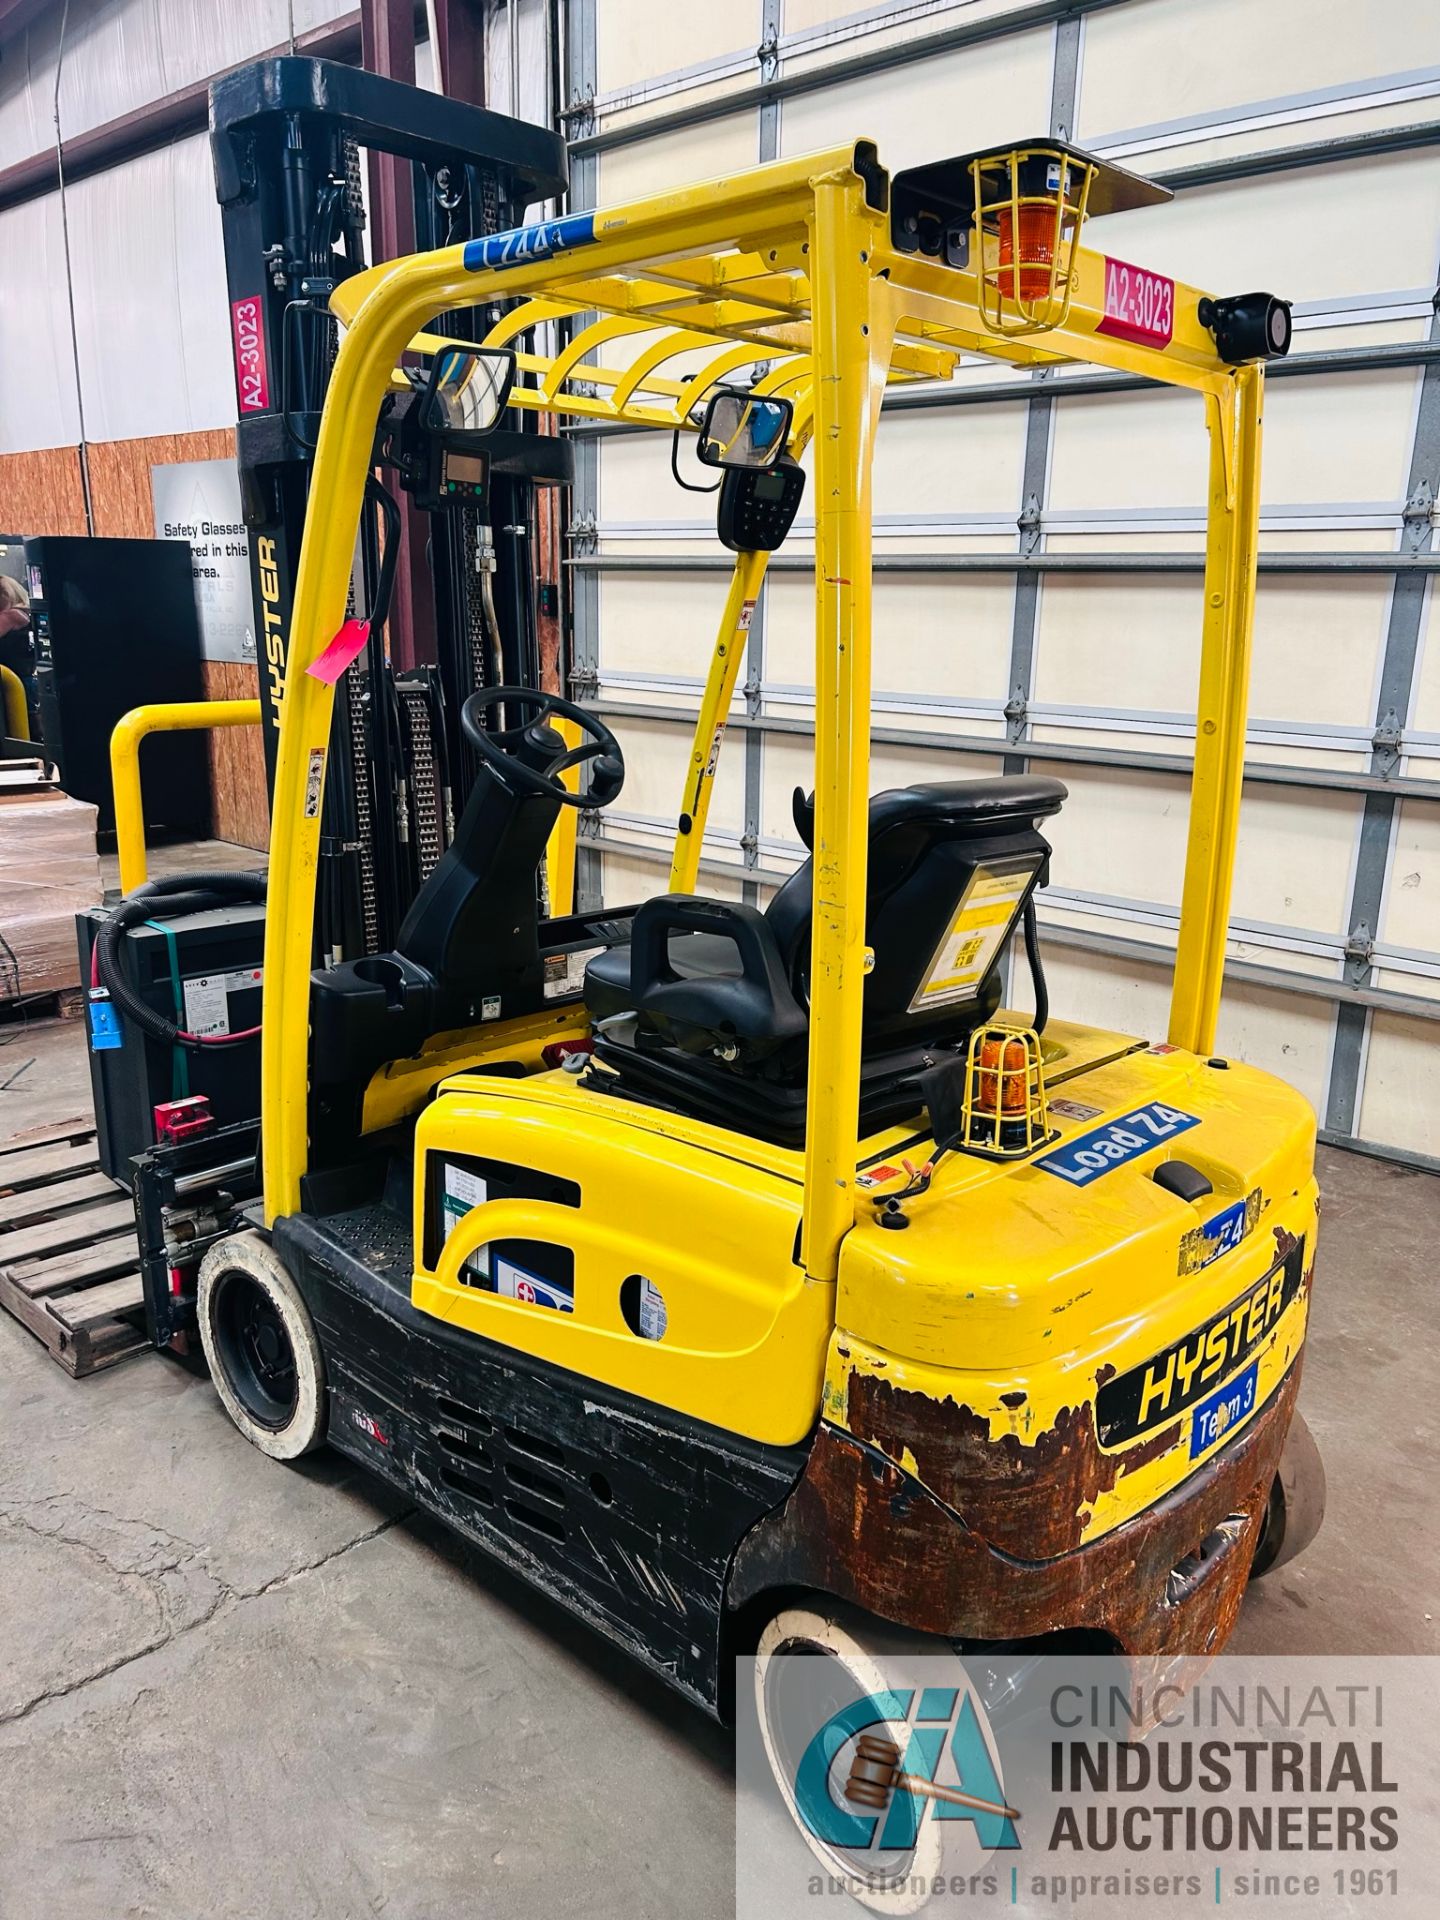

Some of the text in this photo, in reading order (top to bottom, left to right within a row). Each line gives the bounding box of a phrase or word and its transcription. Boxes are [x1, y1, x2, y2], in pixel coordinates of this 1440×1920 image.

[1106, 263, 1171, 335] A2-3023
[236, 302, 263, 408] A2-3023
[164, 521, 246, 538] Safety Glasses
[212, 543, 222, 557] in
[226, 543, 248, 557] this
[193, 566, 221, 579] area.
[257, 535, 286, 729] HYSTER
[1039, 1125, 1150, 1182] Load
[1125, 1104, 1193, 1137] Z4
[1137, 1265, 1286, 1426] HYSTER
[1199, 1376, 1254, 1445] Tem 3
